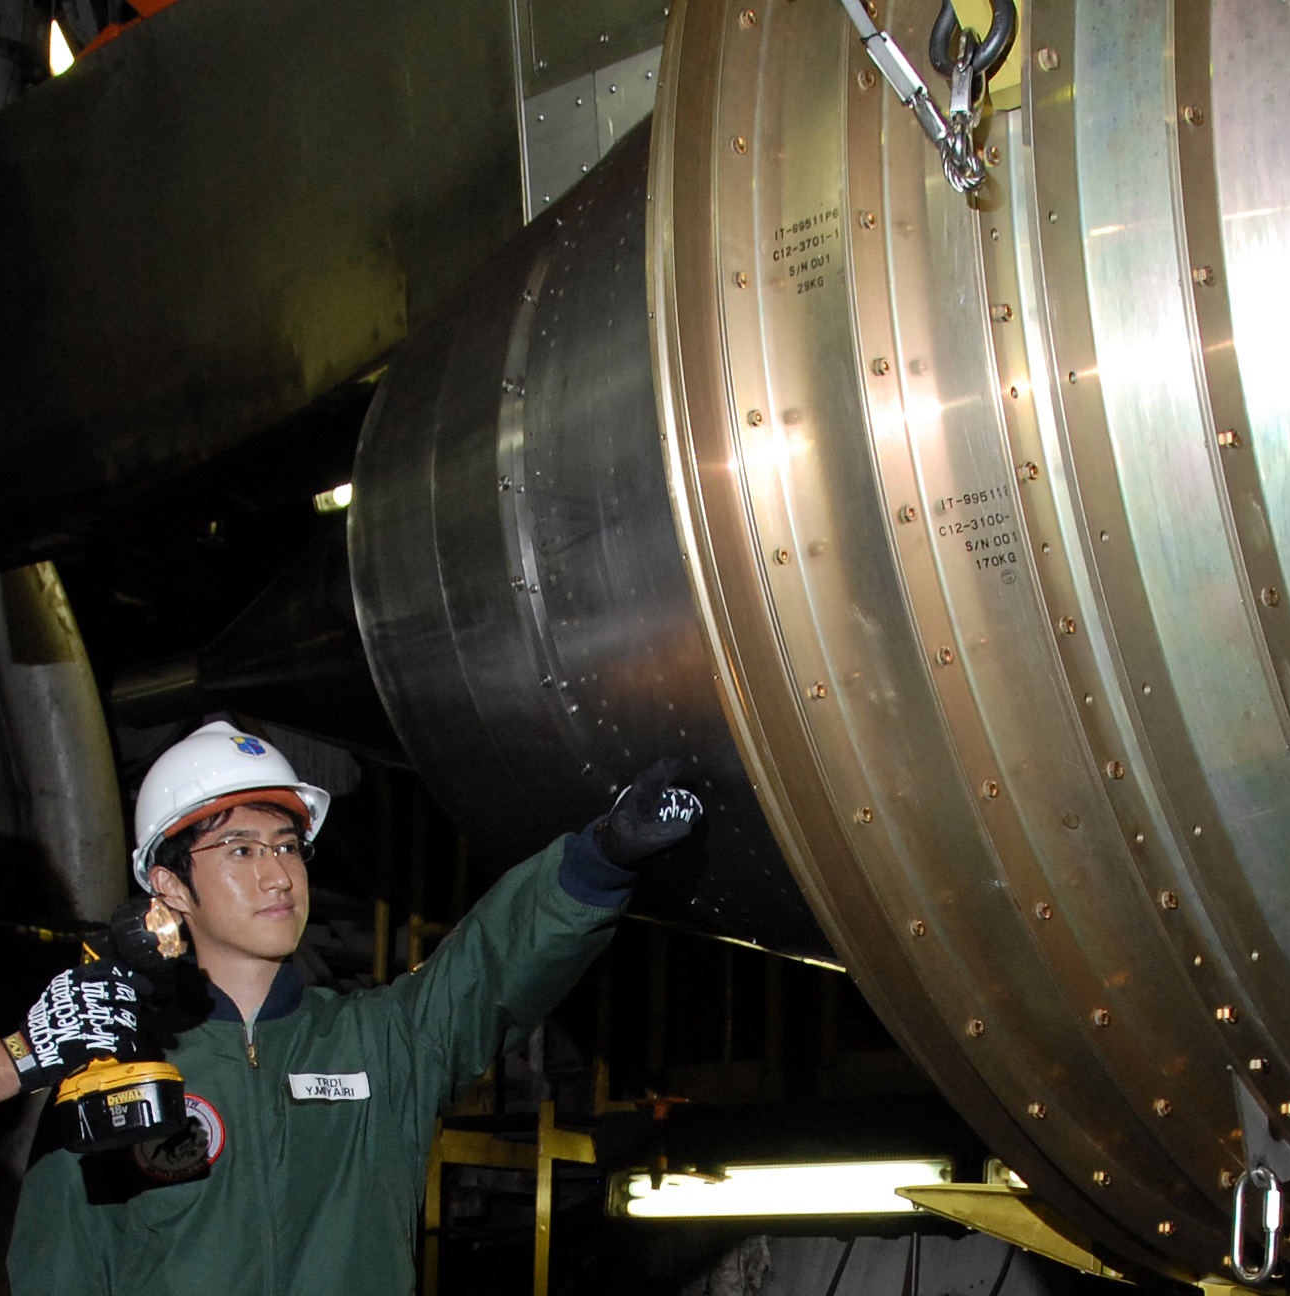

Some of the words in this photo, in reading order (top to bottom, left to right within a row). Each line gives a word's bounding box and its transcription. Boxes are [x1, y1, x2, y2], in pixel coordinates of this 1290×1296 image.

[773, 228, 840, 262] C12-3701-1
[811, 252, 831, 270] 001
[797, 276, 825, 295] 29KG
[965, 537, 990, 552] S/N
[993, 531, 1018, 547] 001
[975, 551, 1017, 571] 170KG
[315, 1077, 343, 1088] TRDI
